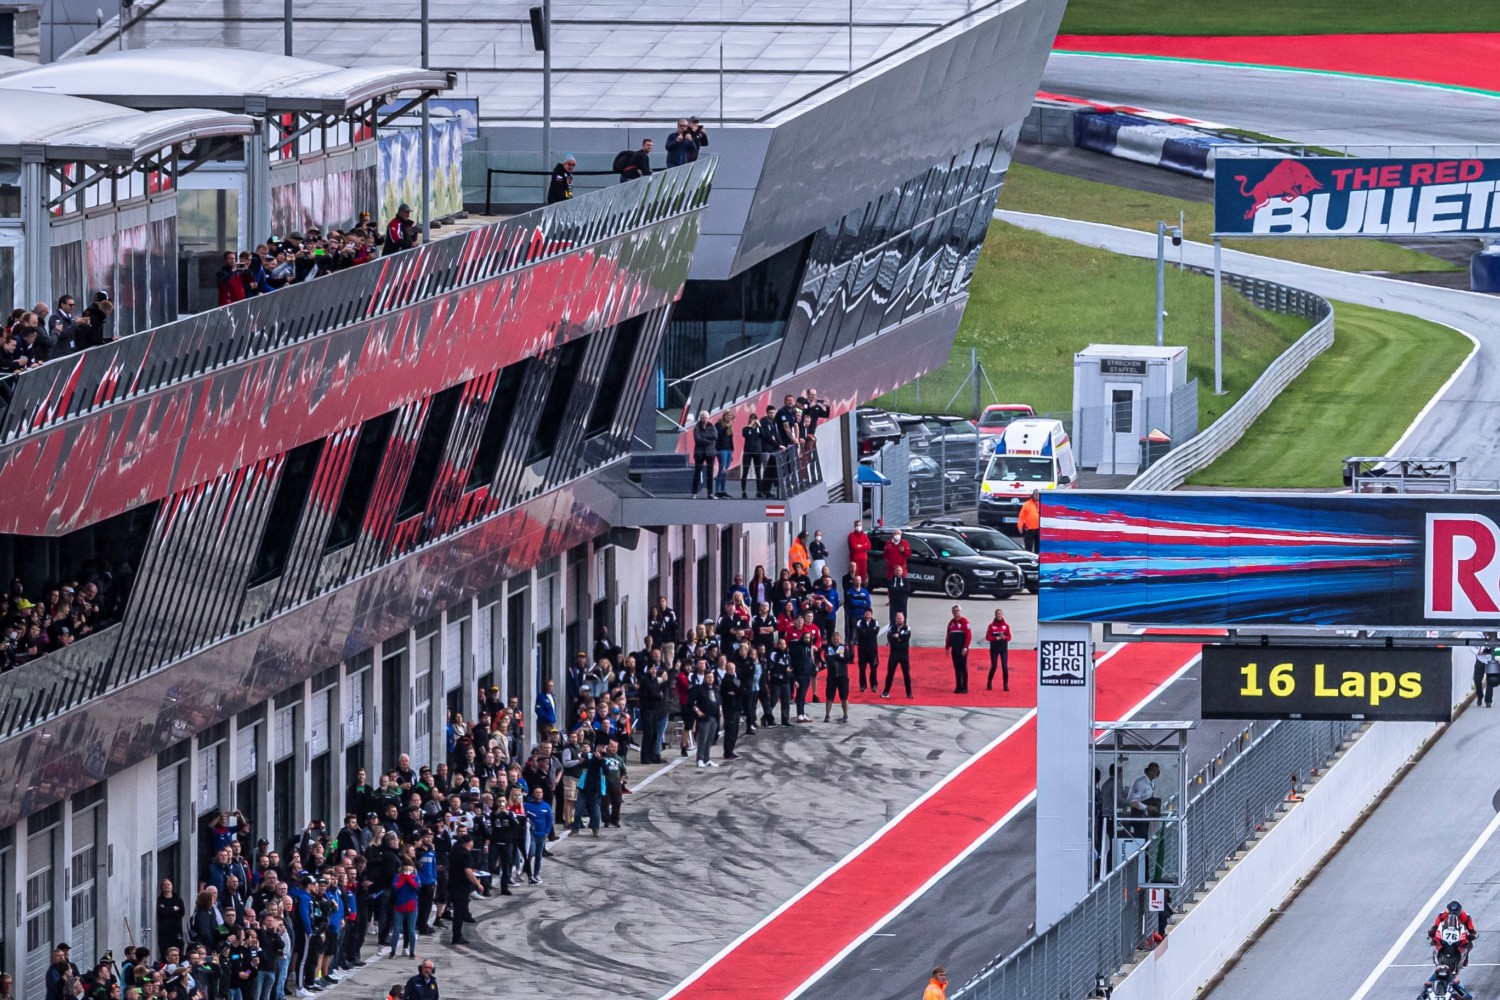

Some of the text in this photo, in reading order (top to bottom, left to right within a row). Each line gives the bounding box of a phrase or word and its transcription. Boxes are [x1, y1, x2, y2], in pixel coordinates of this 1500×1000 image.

[1331, 160, 1484, 191] THE RED
[906, 572, 923, 580] DICAL
[1042, 642, 1084, 657] SPIEL
[1042, 657, 1081, 672] BERG
[1240, 663, 1423, 706] 16 Laps
[1445, 932, 1458, 941] 76
